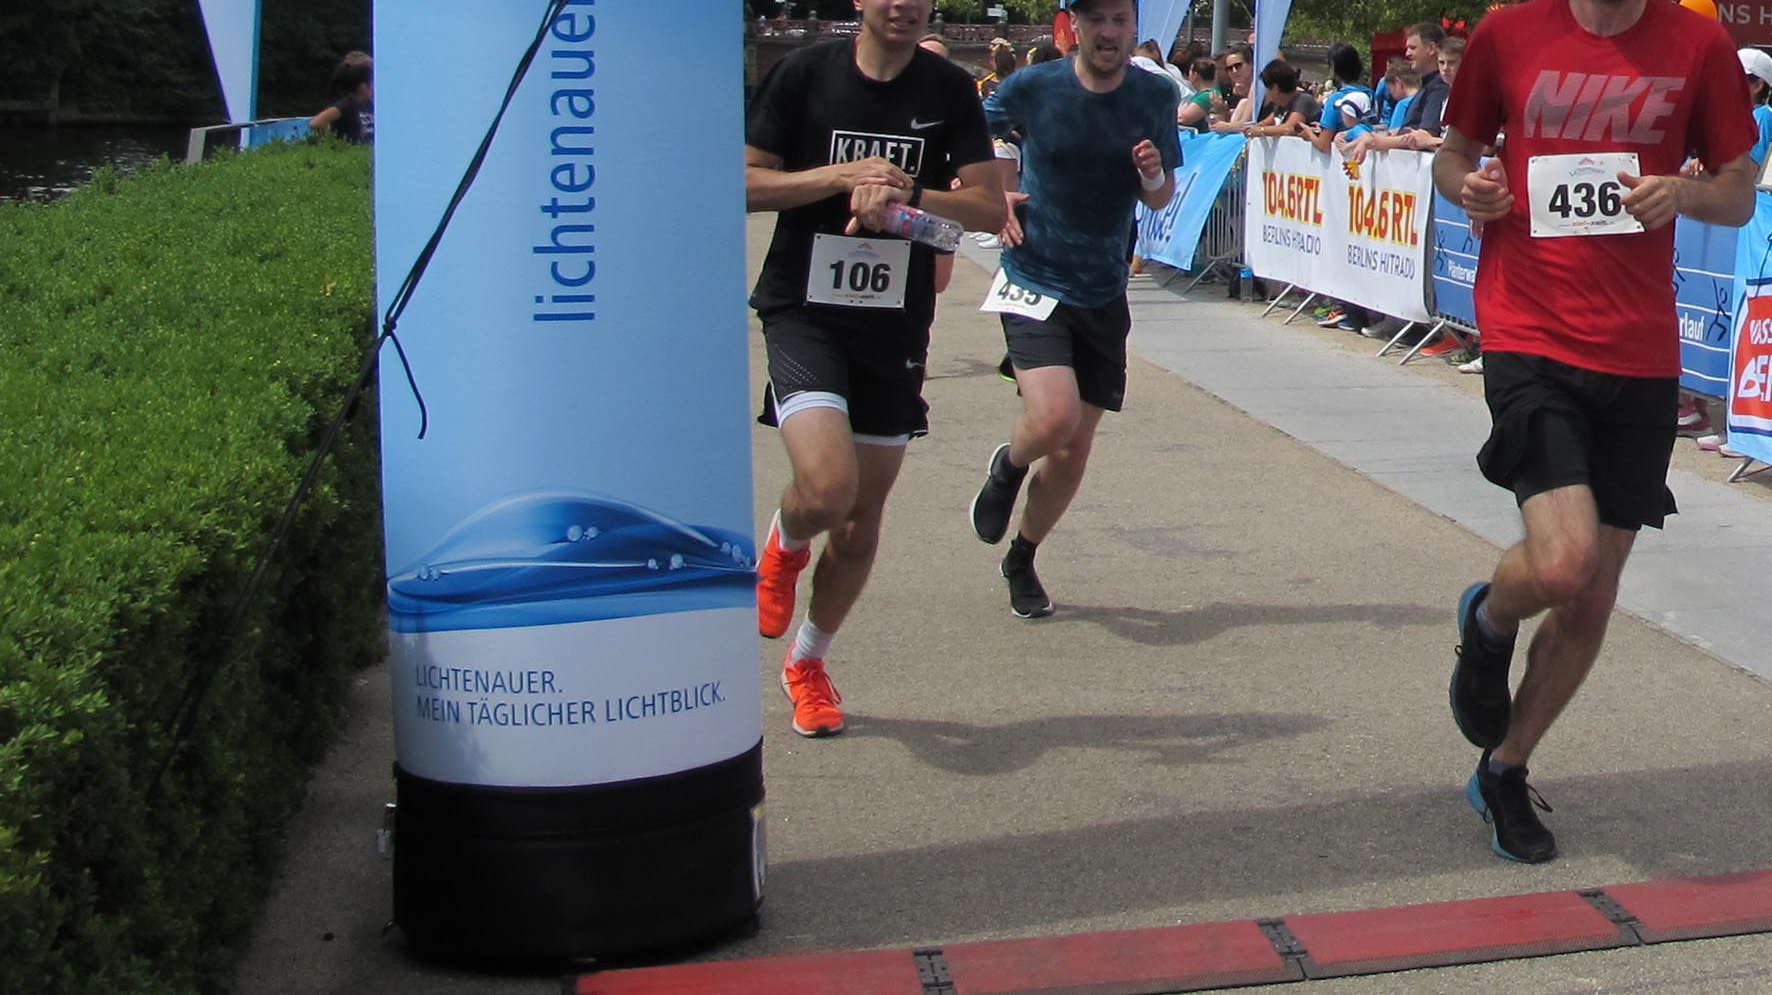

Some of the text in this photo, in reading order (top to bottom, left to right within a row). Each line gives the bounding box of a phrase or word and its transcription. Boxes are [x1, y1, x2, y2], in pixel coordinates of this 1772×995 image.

[1523, 70, 1687, 145] NIKE
[1548, 181, 1622, 219] 436
[829, 259, 892, 294] 106
[415, 664, 564, 695] LICHTENAUER.
[416, 680, 727, 727] MEIN TÄGLICHER LICHTBLICK.
